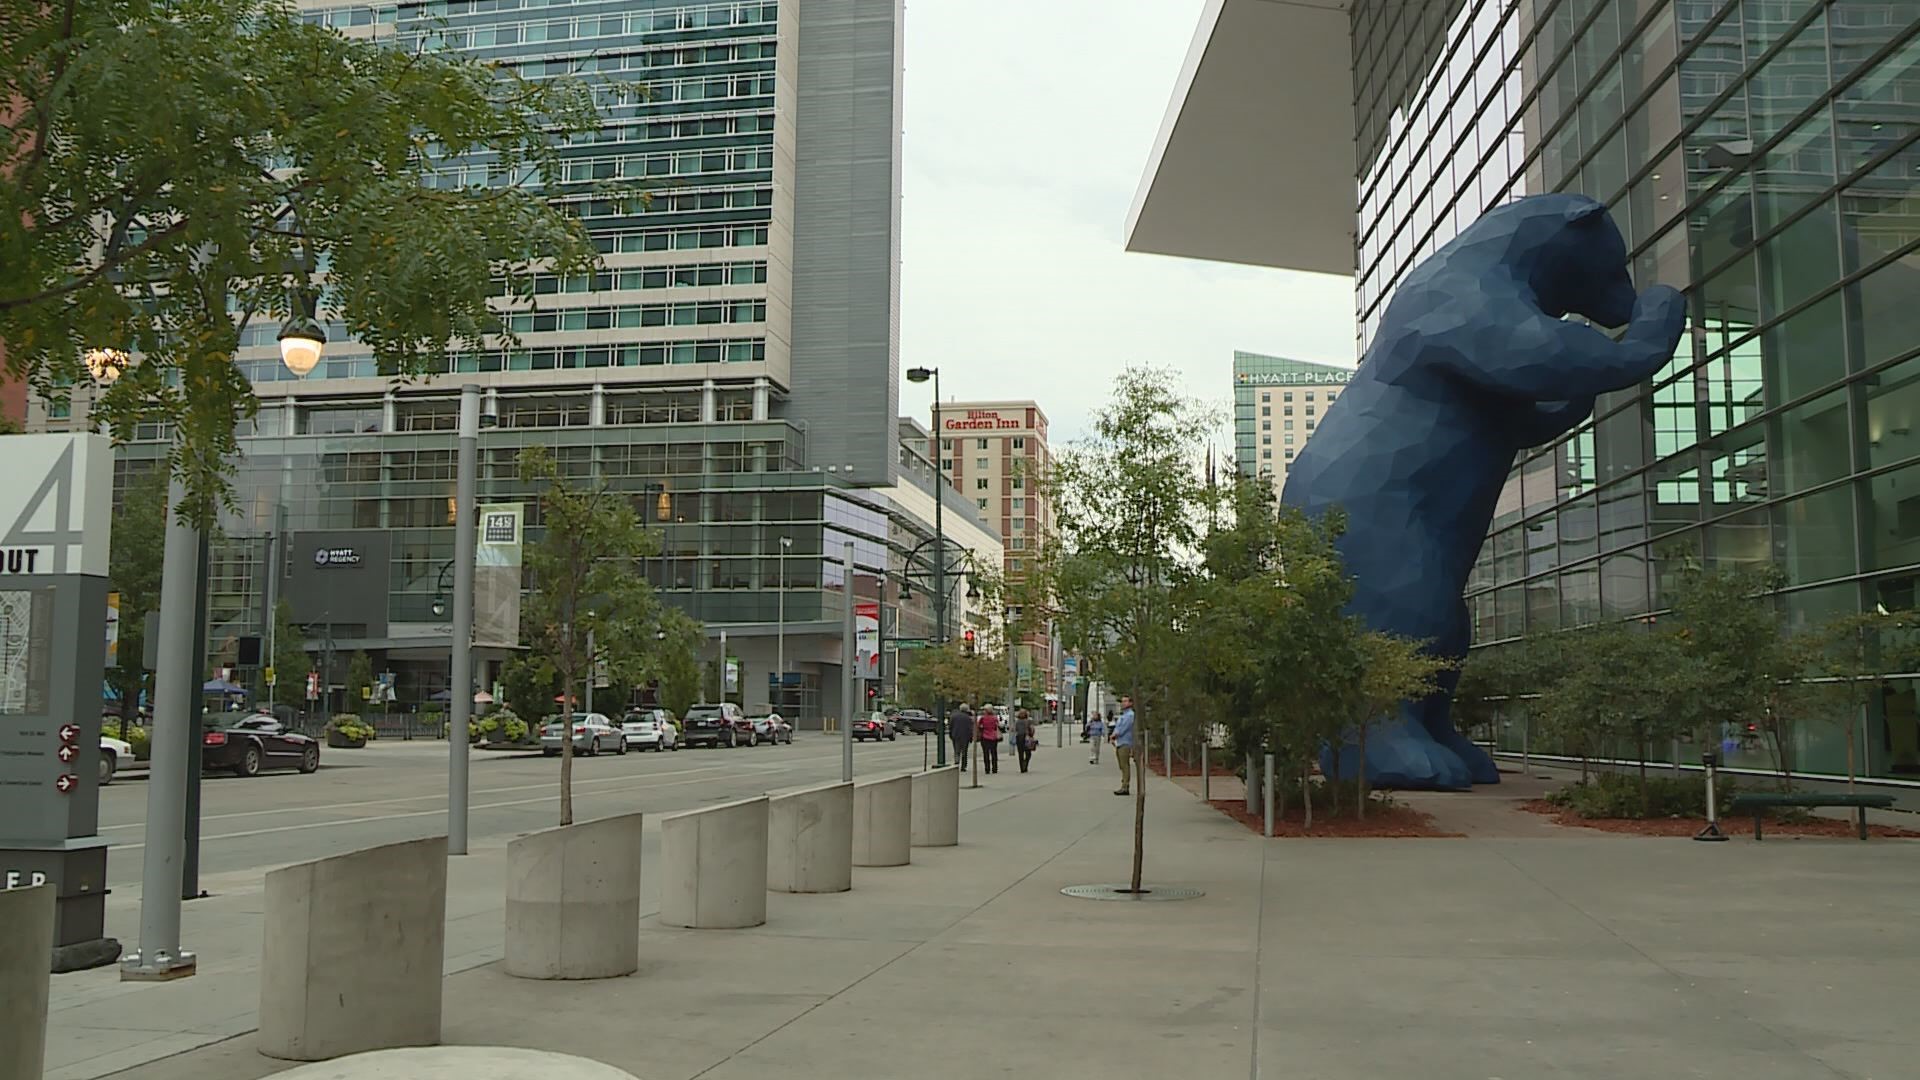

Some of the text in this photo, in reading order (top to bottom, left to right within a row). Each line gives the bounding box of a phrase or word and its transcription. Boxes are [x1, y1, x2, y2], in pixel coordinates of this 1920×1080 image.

[1249, 372, 1298, 384] HYATT
[967, 409, 999, 420] Hilton
[945, 418, 1020, 430] Garden Inn
[330, 555, 360, 563] REGENCY
